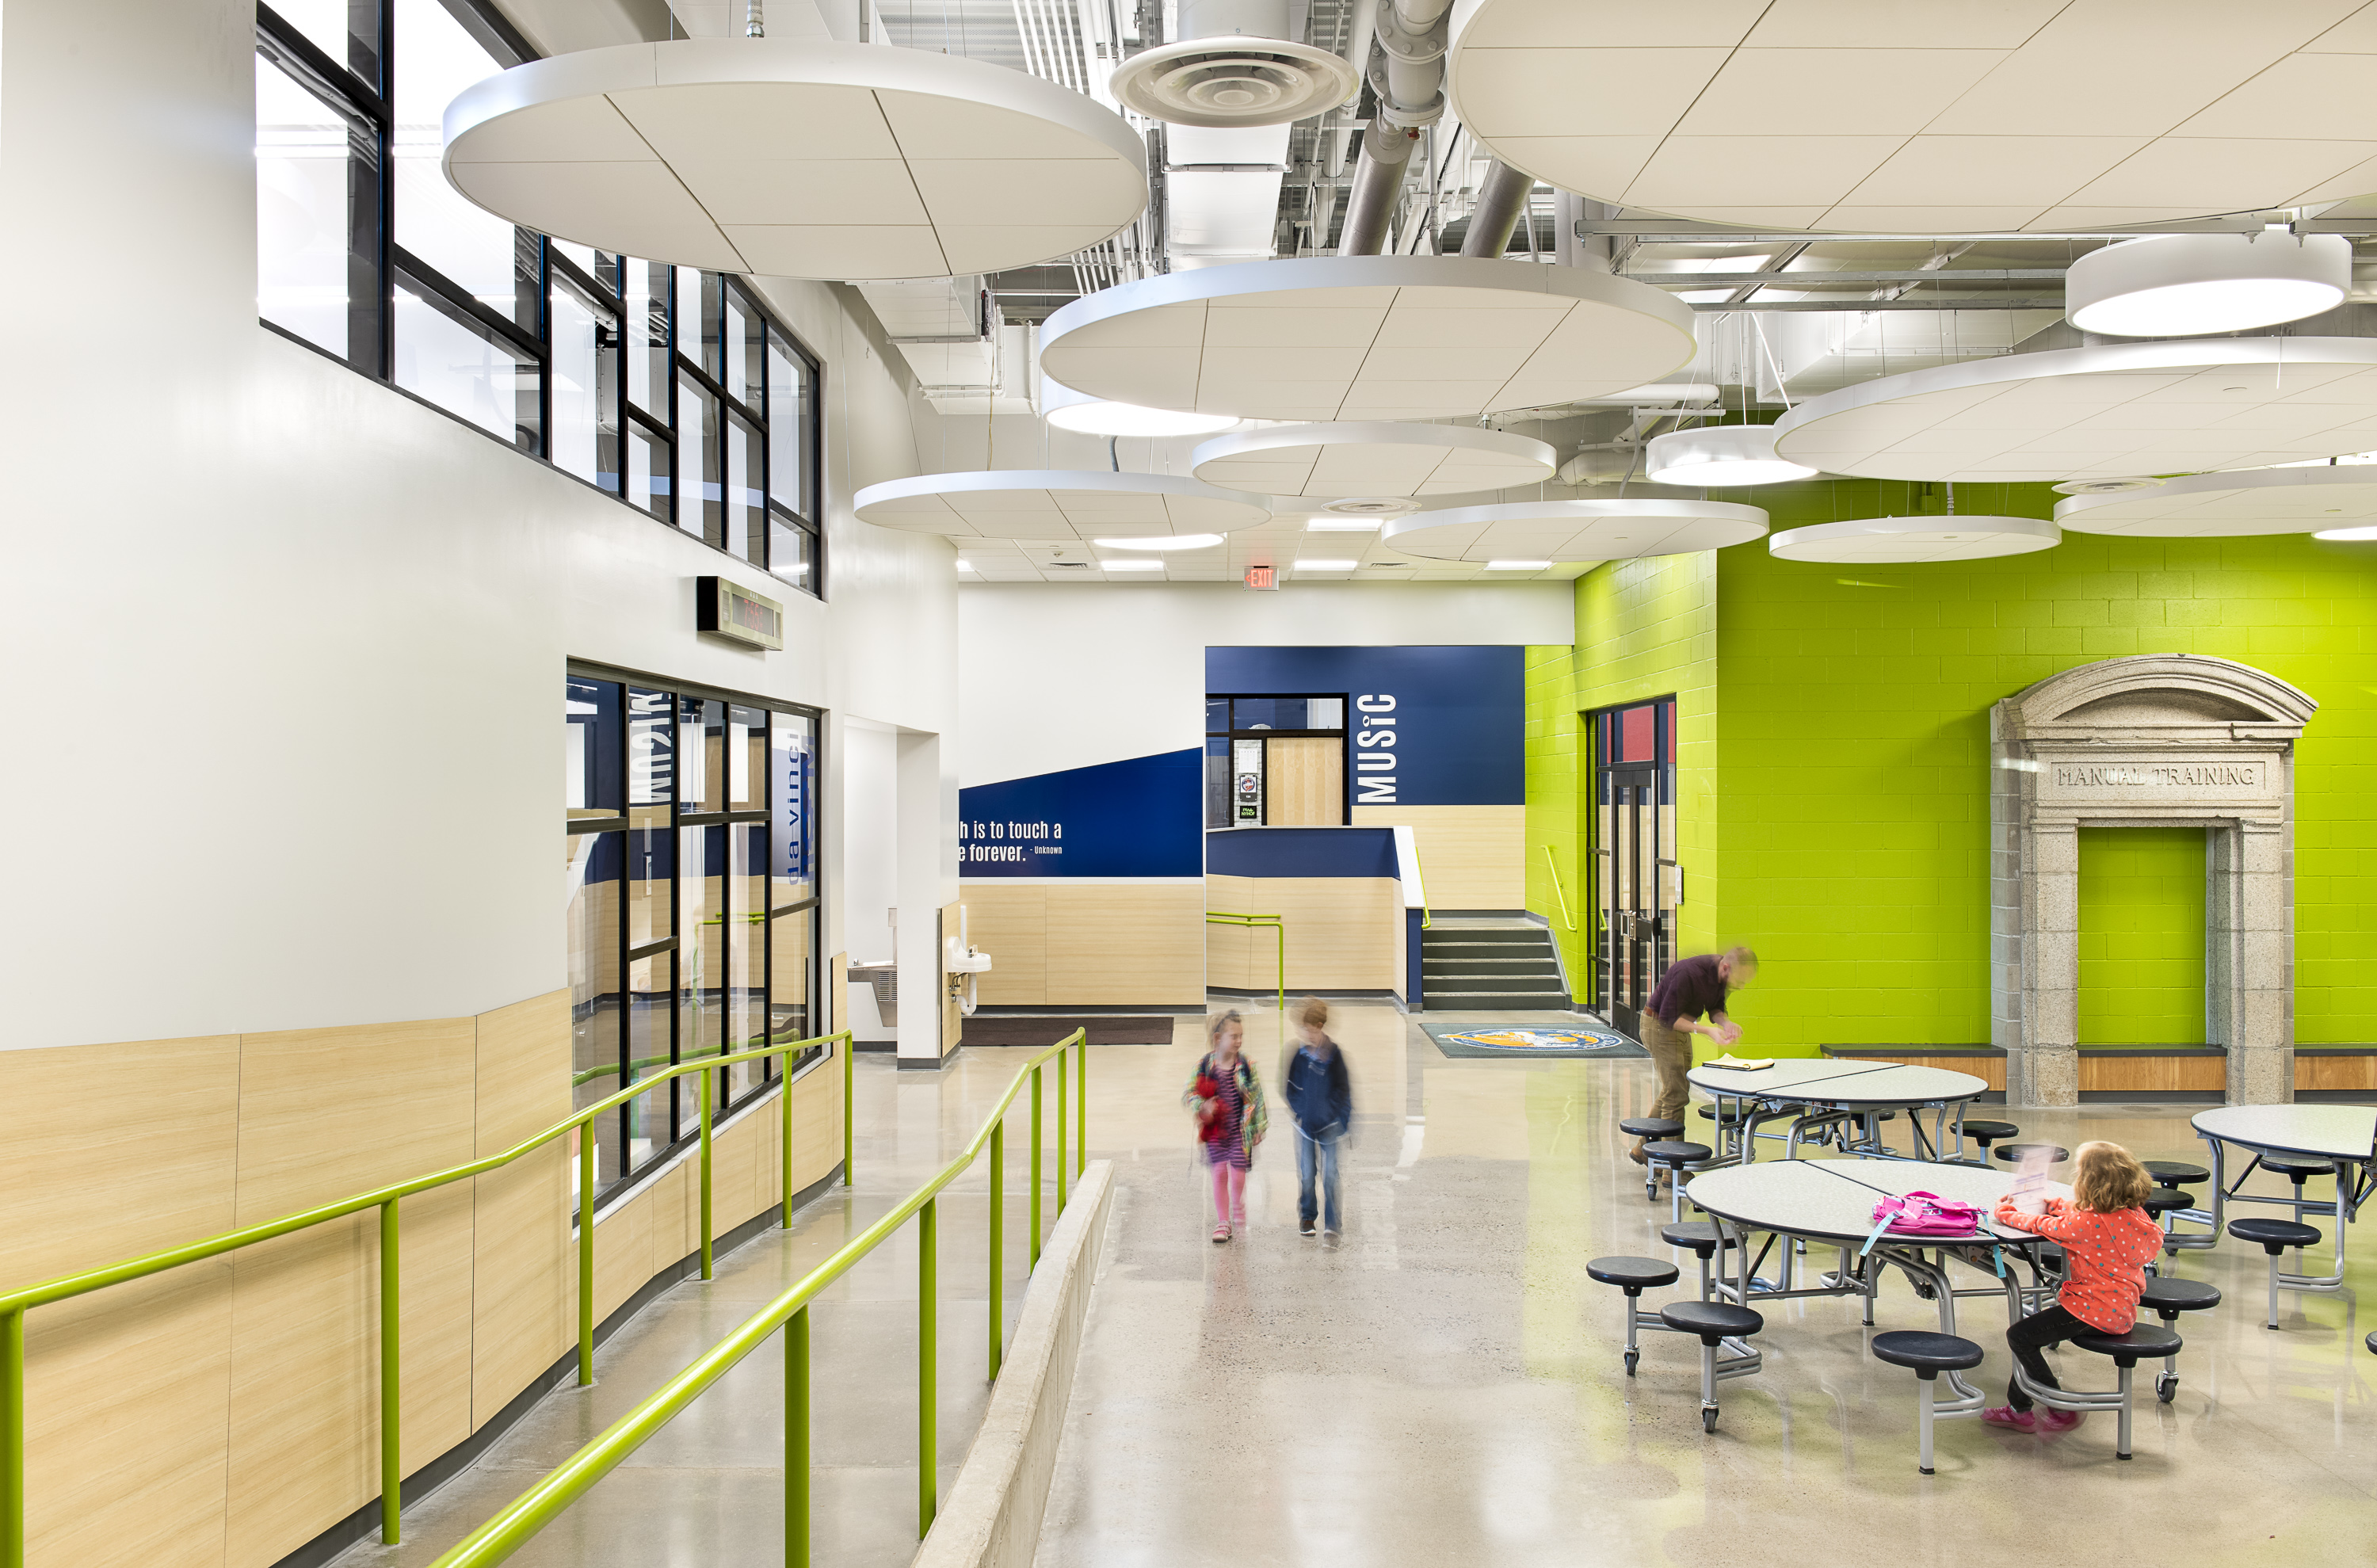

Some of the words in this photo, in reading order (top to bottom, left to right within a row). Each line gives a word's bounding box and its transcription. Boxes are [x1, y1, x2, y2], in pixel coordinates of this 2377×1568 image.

[1250, 569, 1274, 588] EXIT
[787, 733, 799, 826] vinci
[2058, 766, 2145, 787] MANUAL
[2152, 766, 2255, 786] TRAINING
[973, 821, 986, 839] is
[990, 821, 1004, 839] to
[1009, 820, 1048, 839] touch
[1053, 822, 1062, 839] a
[969, 843, 1026, 862] forever.
[1034, 845, 1063, 854] Unknown
[787, 840, 799, 886] da
